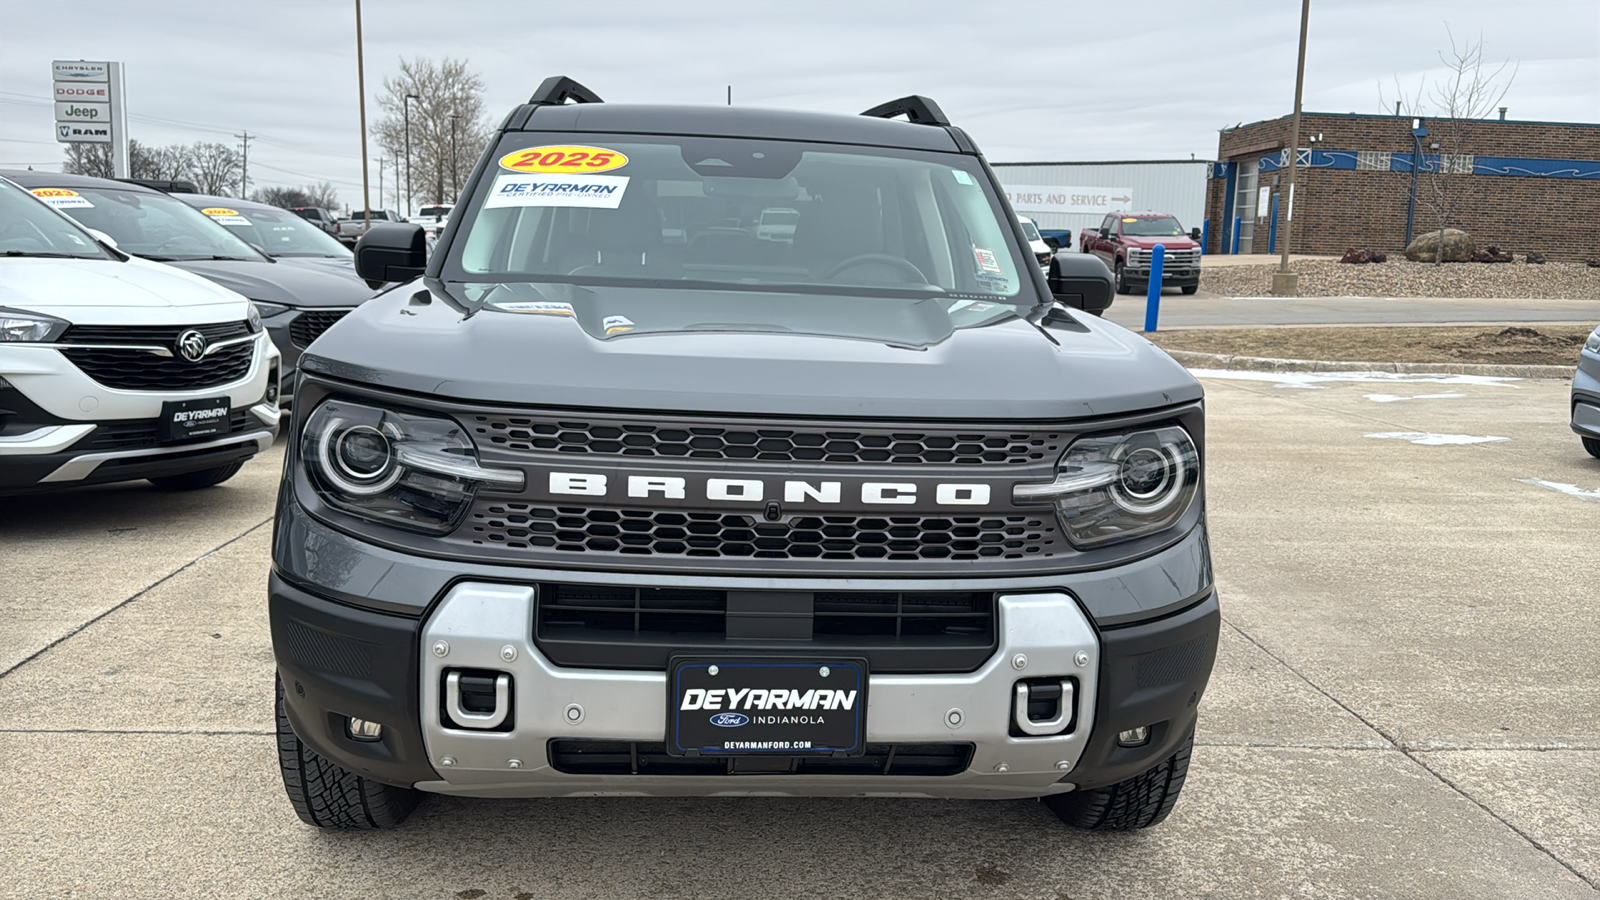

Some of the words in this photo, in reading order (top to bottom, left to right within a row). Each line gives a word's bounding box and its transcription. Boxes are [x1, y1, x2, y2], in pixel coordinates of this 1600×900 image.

[65, 104, 98, 119] Jeep
[511, 152, 615, 167] 2025
[500, 183, 618, 194] DEYARMAN
[1016, 193, 1042, 204] PARTS
[1046, 194, 1066, 205] AND
[1071, 194, 1107, 206] SERVICE
[173, 407, 228, 422] DEYARMAN
[548, 472, 991, 505] BRONCO
[680, 688, 857, 710] DEYARMAN
[716, 714, 742, 725] Ford
[753, 716, 825, 724] INDIANOLA
[724, 741, 812, 749] DEYARMANFORD.COM
